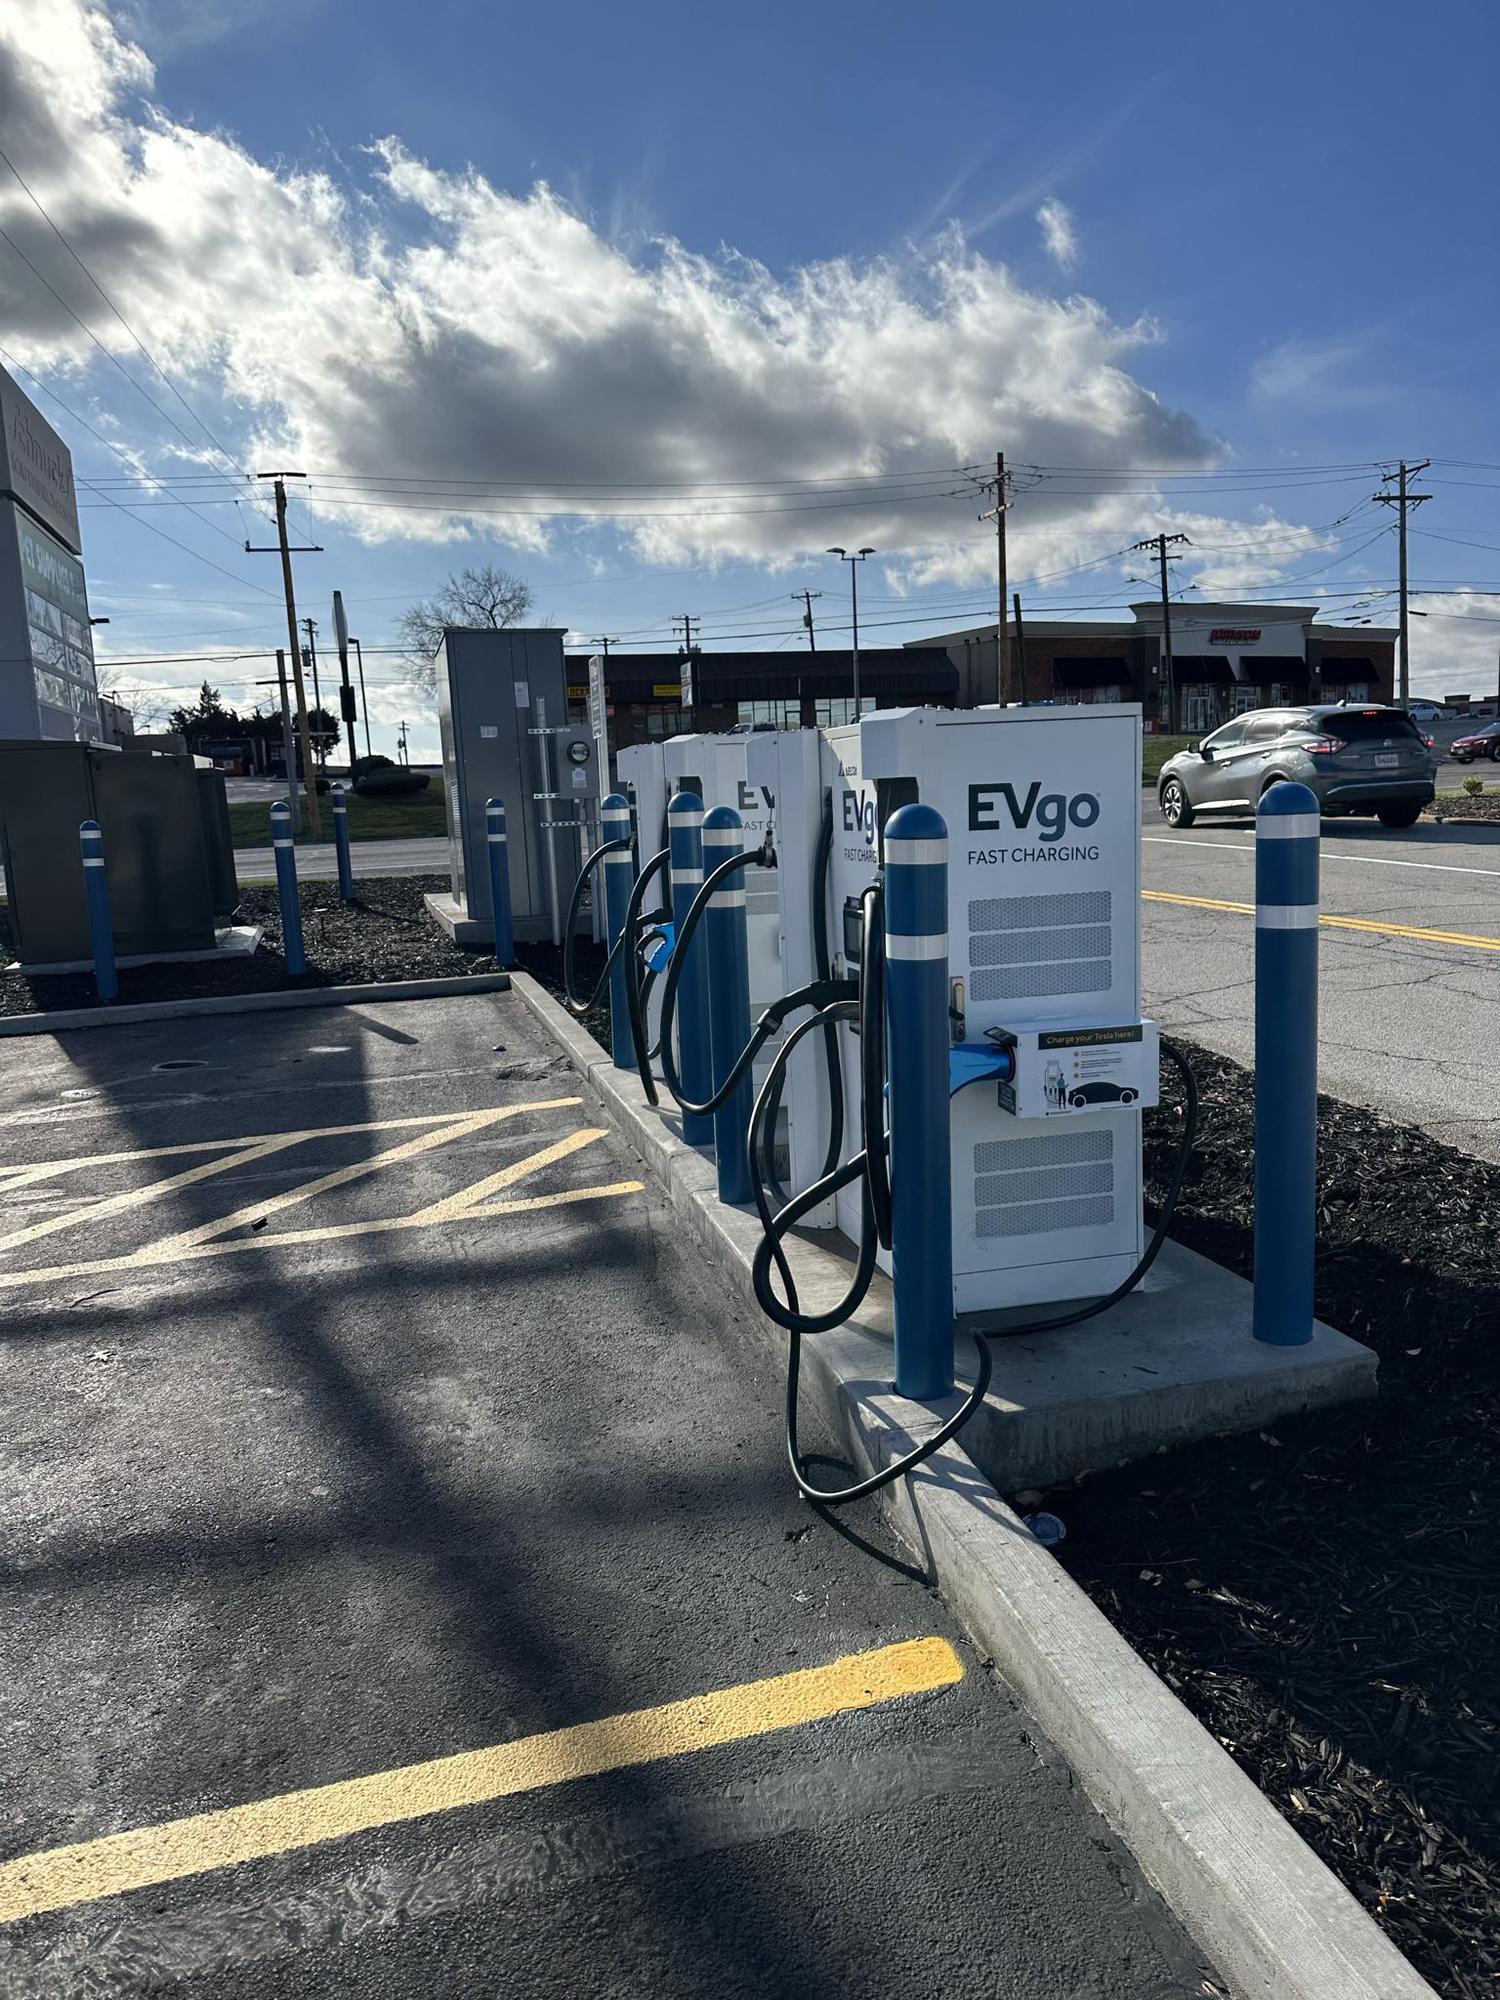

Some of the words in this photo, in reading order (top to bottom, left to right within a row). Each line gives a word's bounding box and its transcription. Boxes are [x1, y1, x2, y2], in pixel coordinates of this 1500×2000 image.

[967, 781, 1101, 842] EVgo
[743, 821, 764, 831] AST
[844, 848, 857, 861] FAST
[968, 849, 1009, 866] FAST
[1011, 845, 1100, 863] CHARGING
[1046, 1035, 1075, 1045] Charge
[1075, 1035, 1094, 1045] your
[1095, 1032, 1114, 1041] Tesla
